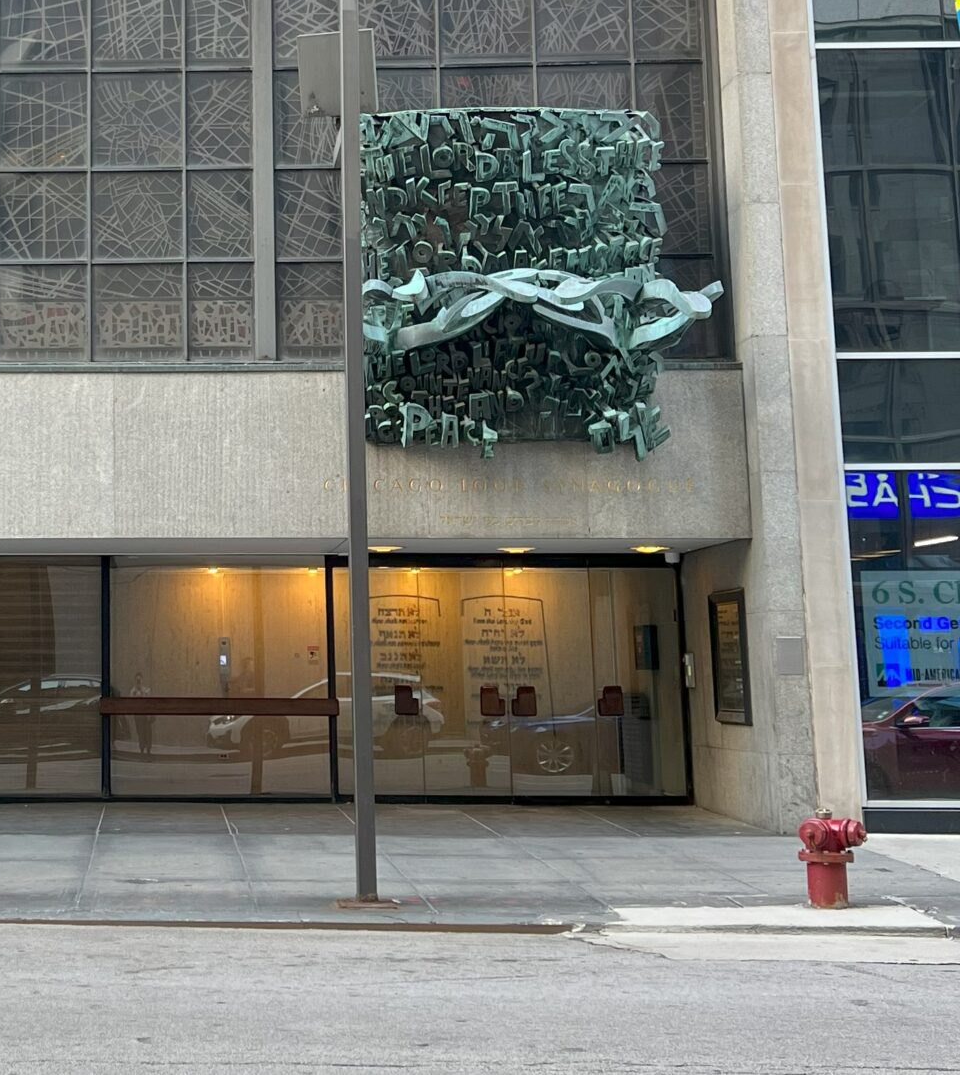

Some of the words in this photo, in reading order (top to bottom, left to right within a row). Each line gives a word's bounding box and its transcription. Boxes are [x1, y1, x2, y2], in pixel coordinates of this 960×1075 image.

[419, 141, 500, 182] LORD
[496, 138, 596, 183] BLESS
[594, 138, 665, 176] THEE
[405, 176, 491, 219] KEEP
[491, 181, 567, 225] THEE
[409, 341, 470, 376] LORD
[468, 385, 525, 421] AND
[399, 402, 498, 458] PEACE
[324, 478, 443, 493] CCAGO
[543, 478, 694, 493] SYNAGOGUE
[871, 580, 890, 604] 6
[898, 580, 924, 604] S.
[874, 615, 932, 630] Second
[875, 636, 932, 650] Suitable
[936, 636, 954, 650] for
